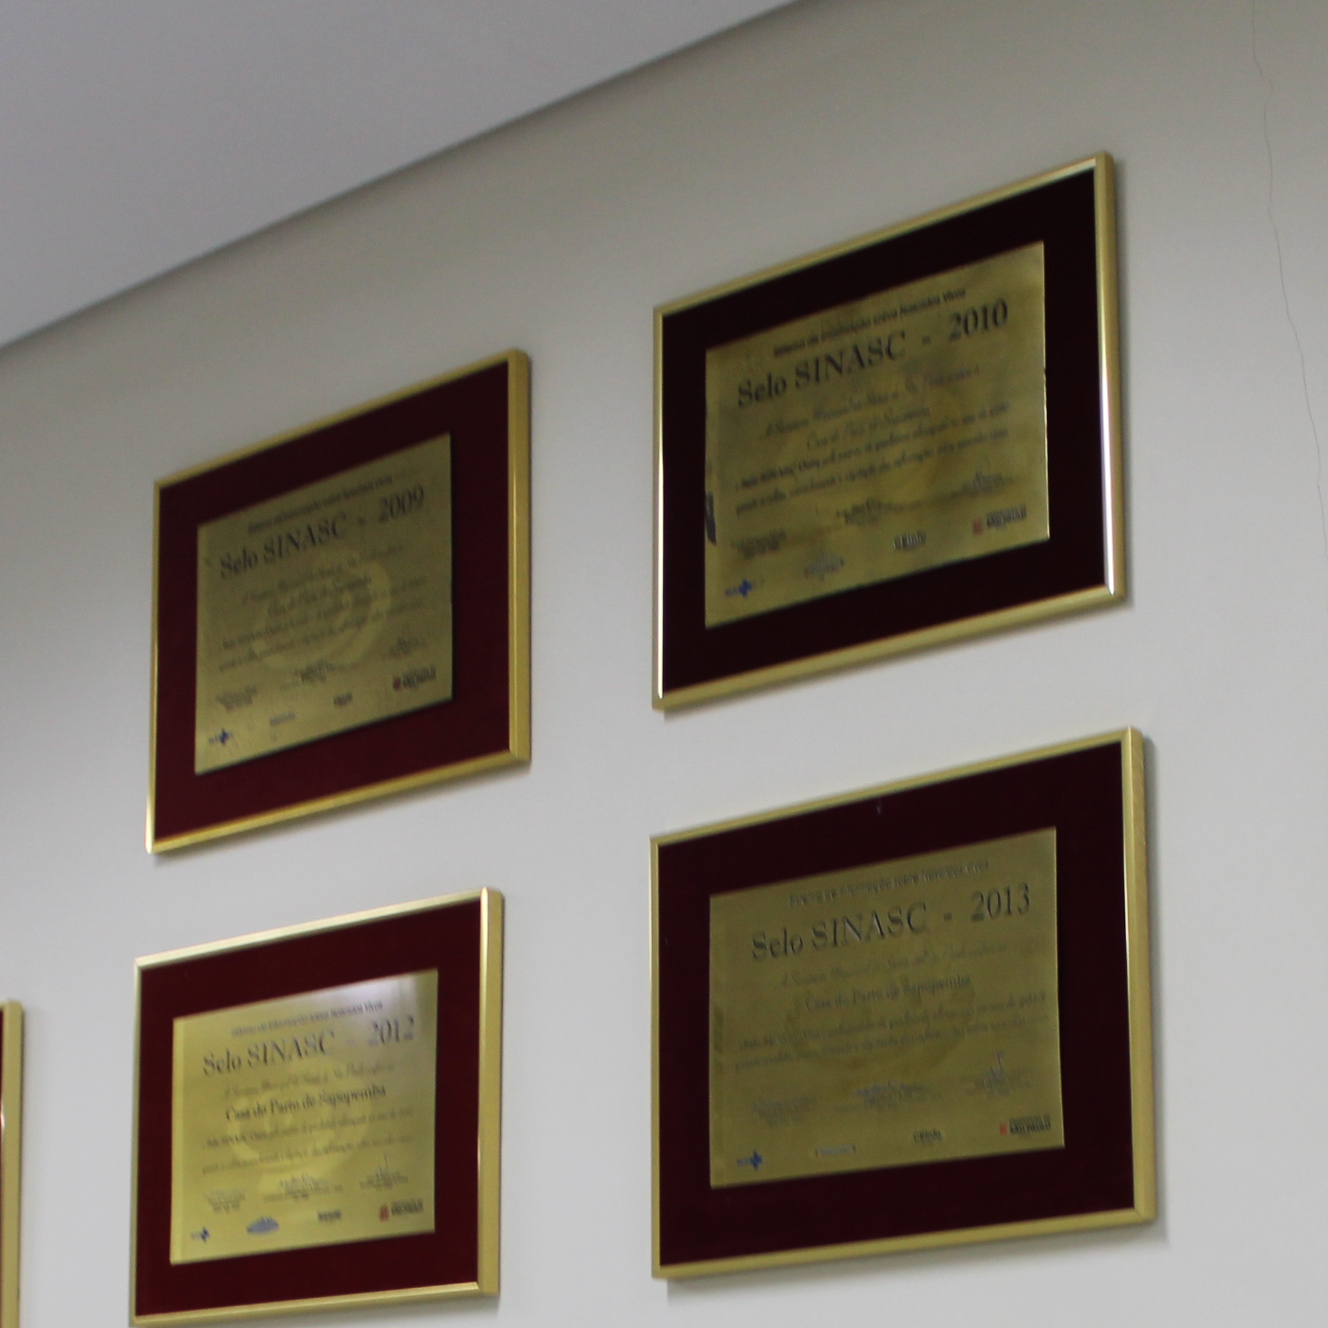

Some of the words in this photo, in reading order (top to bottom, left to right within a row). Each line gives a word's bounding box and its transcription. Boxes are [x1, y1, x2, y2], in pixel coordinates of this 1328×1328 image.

[737, 365, 787, 409] Selo
[794, 327, 906, 391] SINASC
[949, 296, 1007, 344] 2010
[220, 549, 258, 580] Selo
[263, 509, 348, 562] SINASC
[377, 483, 425, 525] 2009
[751, 923, 803, 962] Selo
[811, 900, 927, 952] SINASC
[970, 881, 1030, 924] 2013
[202, 1045, 241, 1077] Selo
[247, 1028, 334, 1069] SINASC
[367, 1013, 414, 1048] 2012
